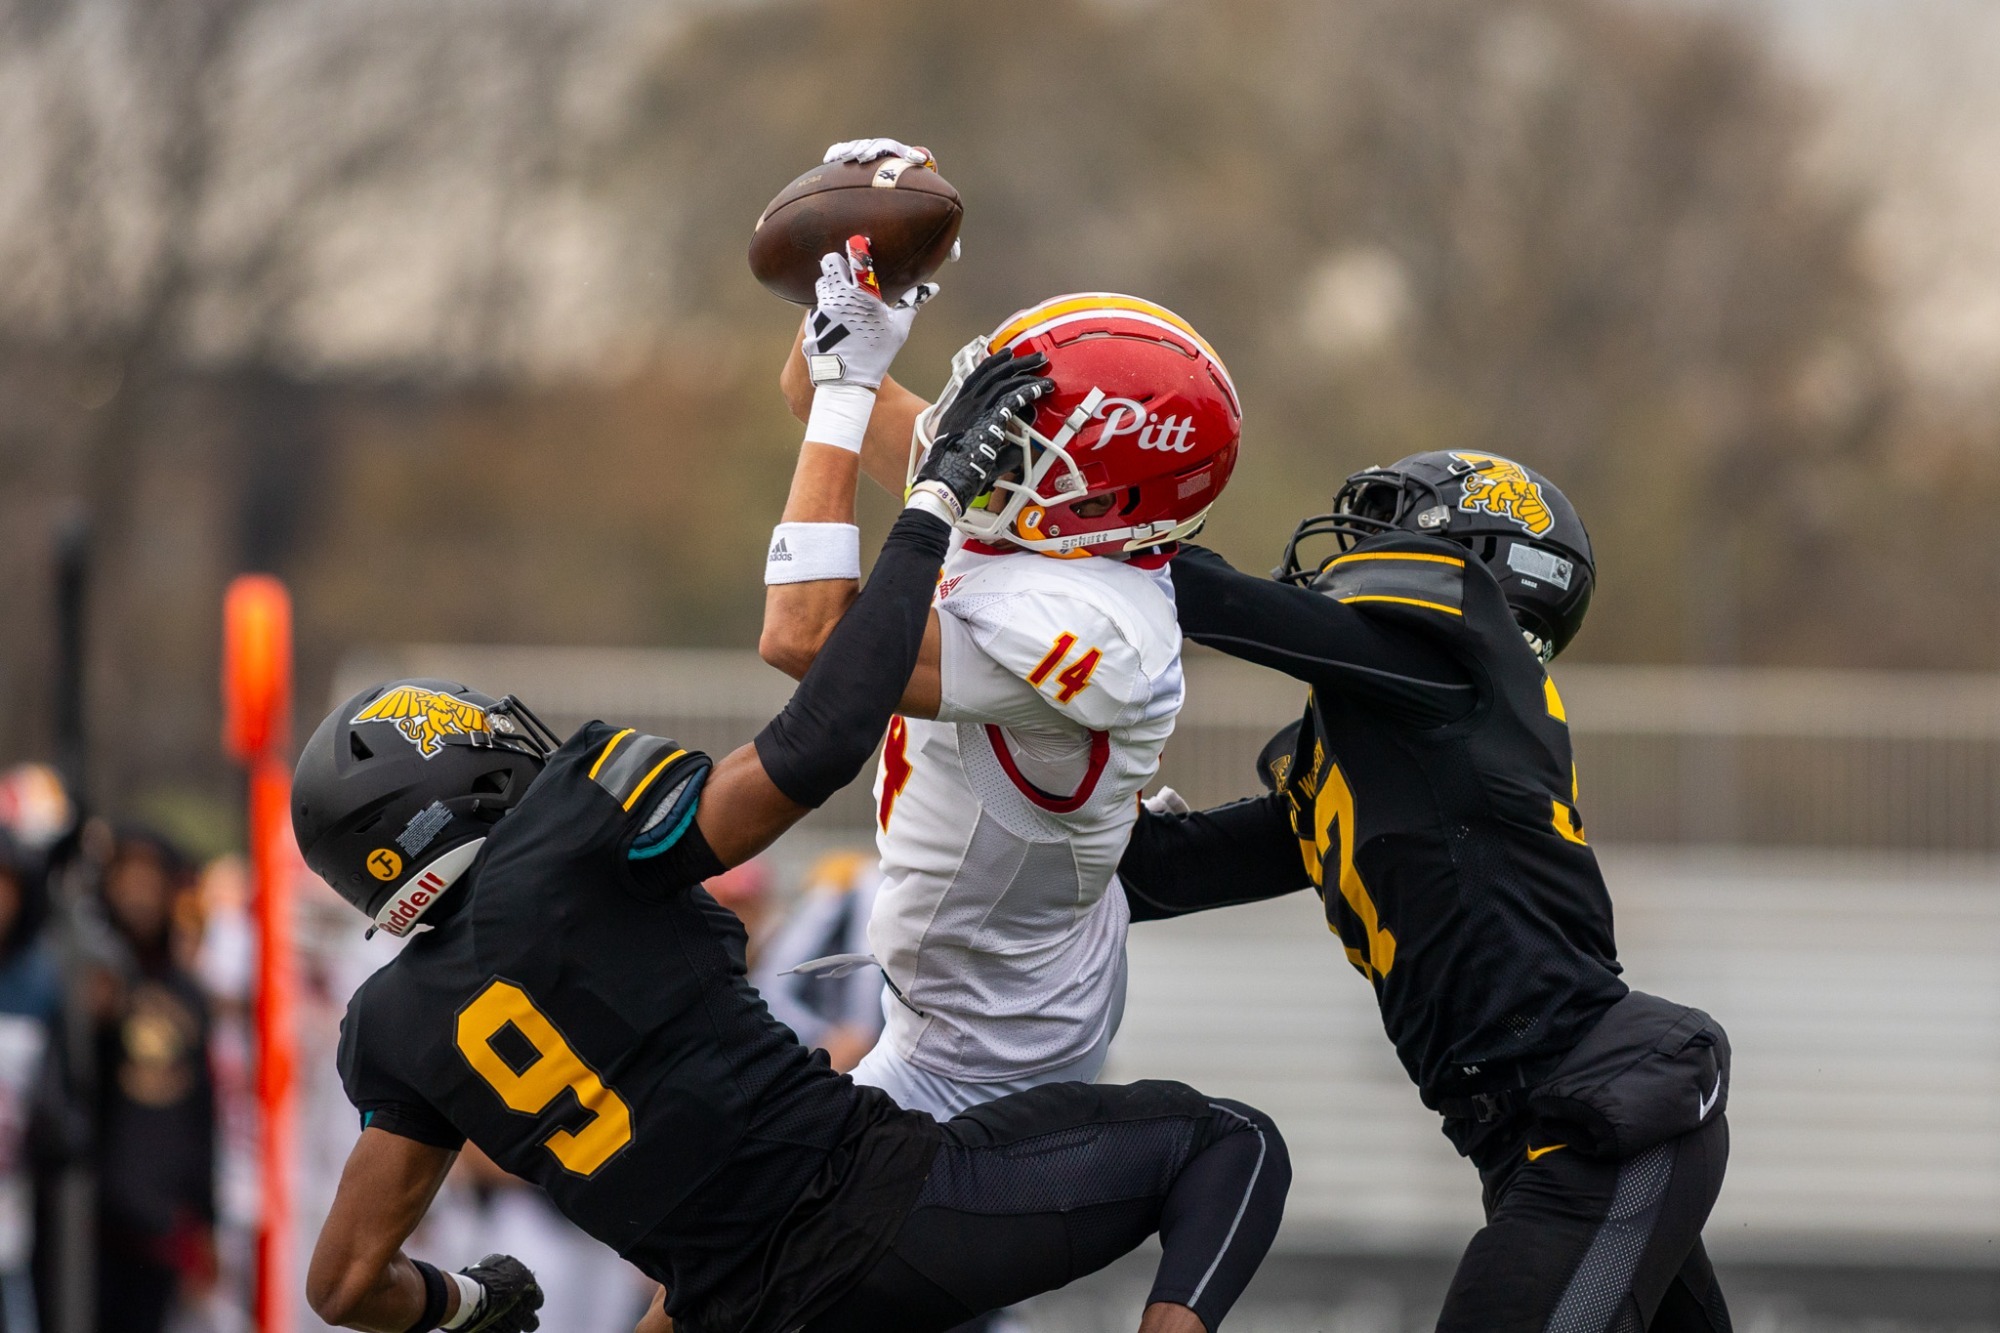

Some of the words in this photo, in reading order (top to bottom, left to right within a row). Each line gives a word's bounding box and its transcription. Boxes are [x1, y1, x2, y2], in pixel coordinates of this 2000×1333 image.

[1090, 397, 1196, 454] Pitt
[1026, 631, 1103, 705] 14
[455, 976, 635, 1179] 9
